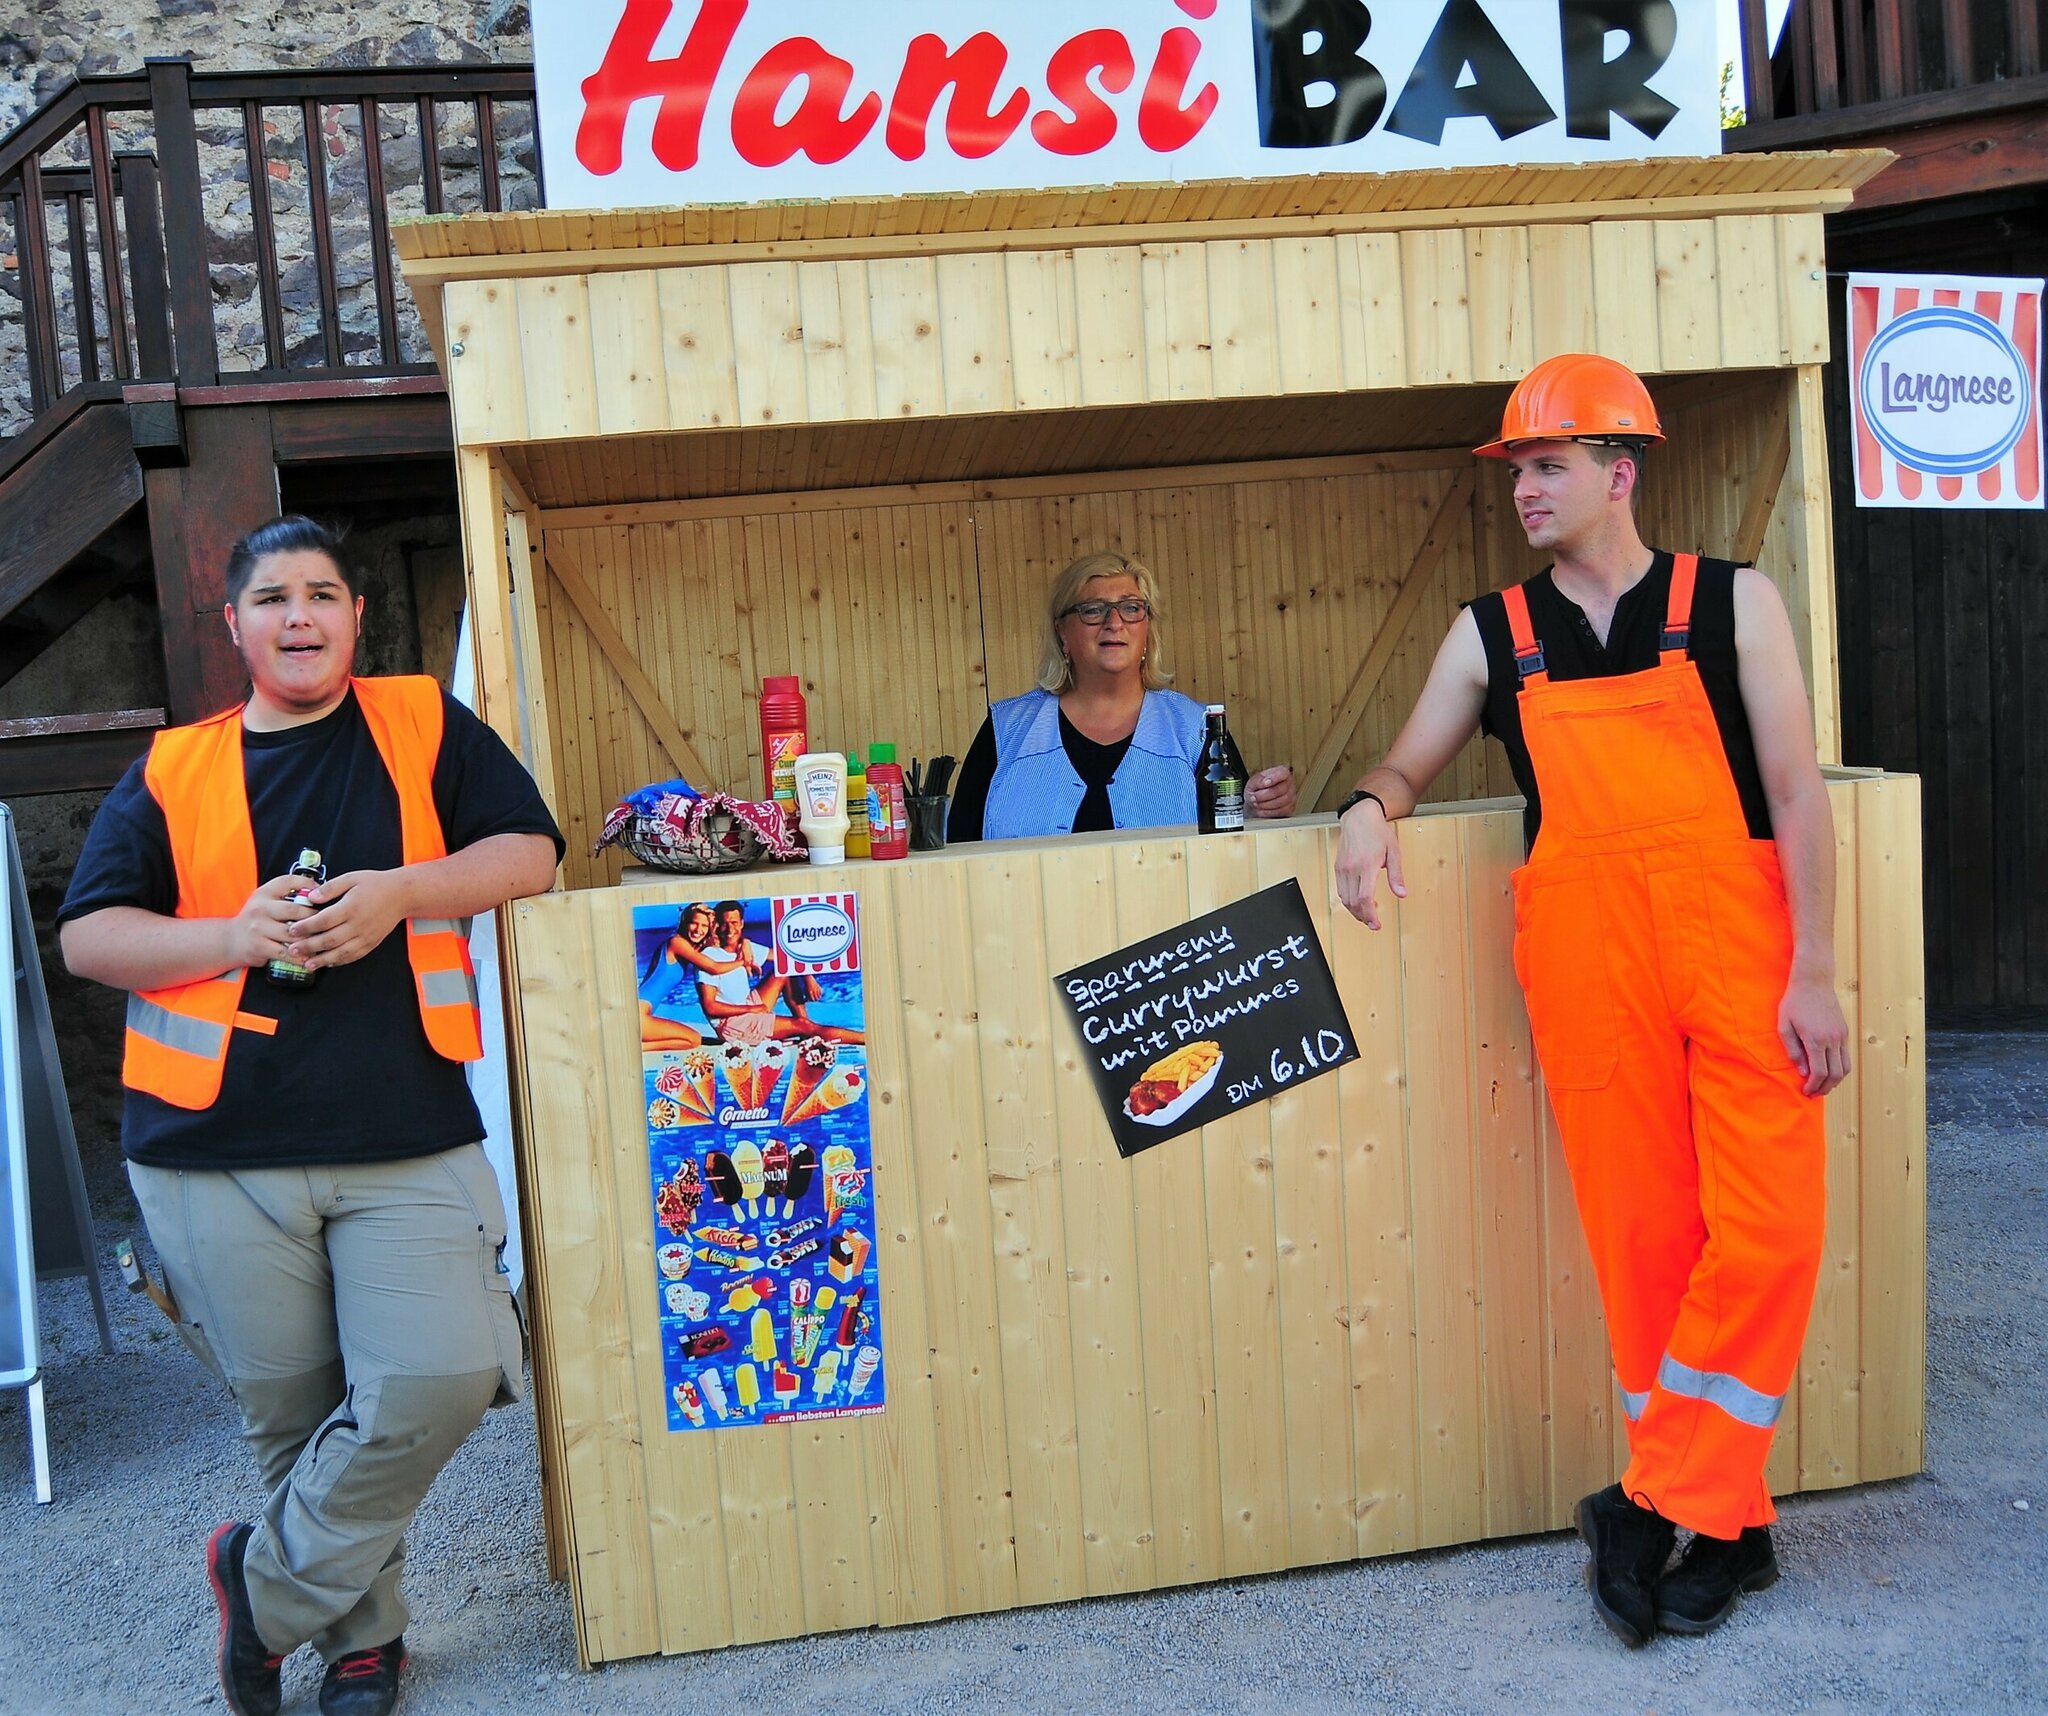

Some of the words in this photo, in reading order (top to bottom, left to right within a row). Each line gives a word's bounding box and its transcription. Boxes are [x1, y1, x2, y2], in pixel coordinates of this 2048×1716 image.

[574, 0, 1219, 176] Hansi
[1253, 0, 1680, 148] BAR
[1880, 362, 2016, 414] Langnese
[811, 772, 833, 781] HEINZ
[786, 924, 847, 944] Langnese
[1083, 935, 1309, 1044] Currywurst
[1100, 1031, 1169, 1071] mit
[1171, 978, 1300, 1041] Pommes
[1226, 1074, 1263, 1104] DM
[718, 1105, 769, 1126] Cornetto
[741, 1167, 788, 1184] MAGNUM
[793, 1313, 826, 1325] CALIPPO
[796, 1409, 835, 1421] liebsten
[835, 1405, 886, 1418] Langnese!
